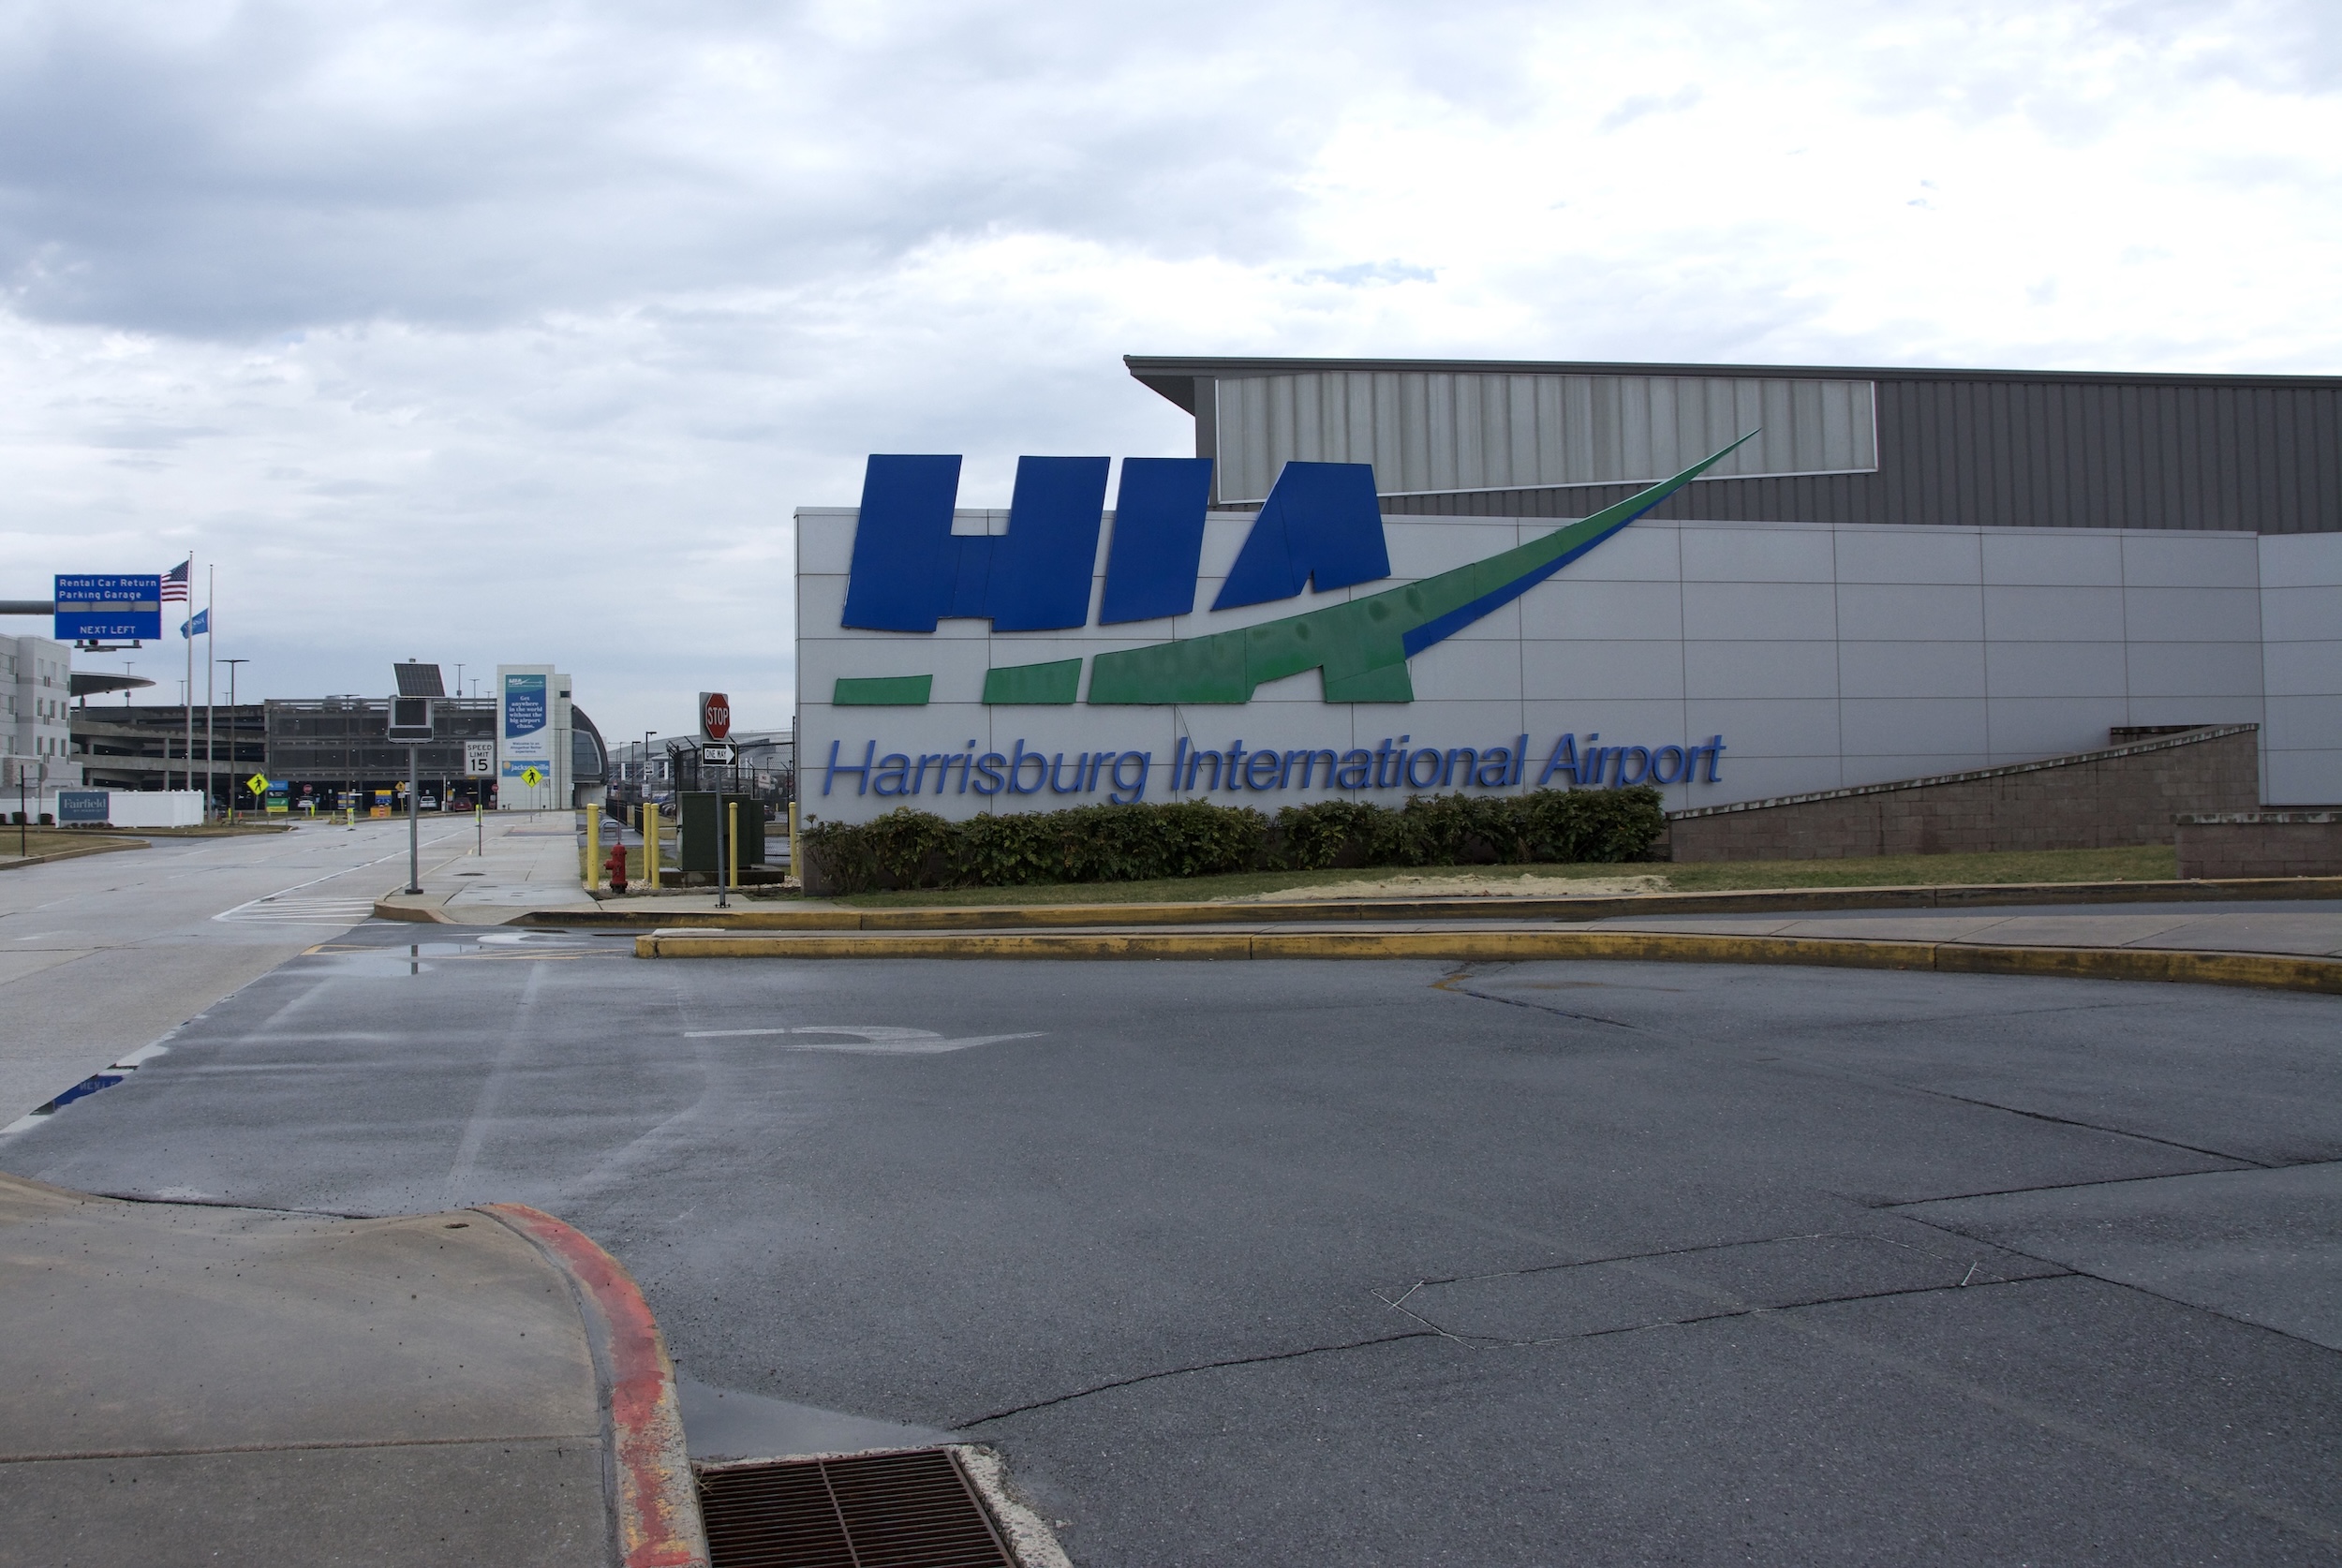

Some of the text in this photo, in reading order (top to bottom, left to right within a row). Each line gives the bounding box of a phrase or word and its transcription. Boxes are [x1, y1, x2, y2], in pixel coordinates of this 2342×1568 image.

[59, 579, 156, 587] Rental Car Return
[59, 590, 142, 600] Parking Garage
[80, 626, 136, 634] NEXT LEFT
[707, 706, 728, 726] STOP
[705, 749, 727, 758] ONE WAY
[471, 759, 488, 771] 15
[511, 763, 549, 772] jacksville
[823, 732, 1727, 805] Harrisburg International Airport
[64, 798, 106, 808] Fairfield
